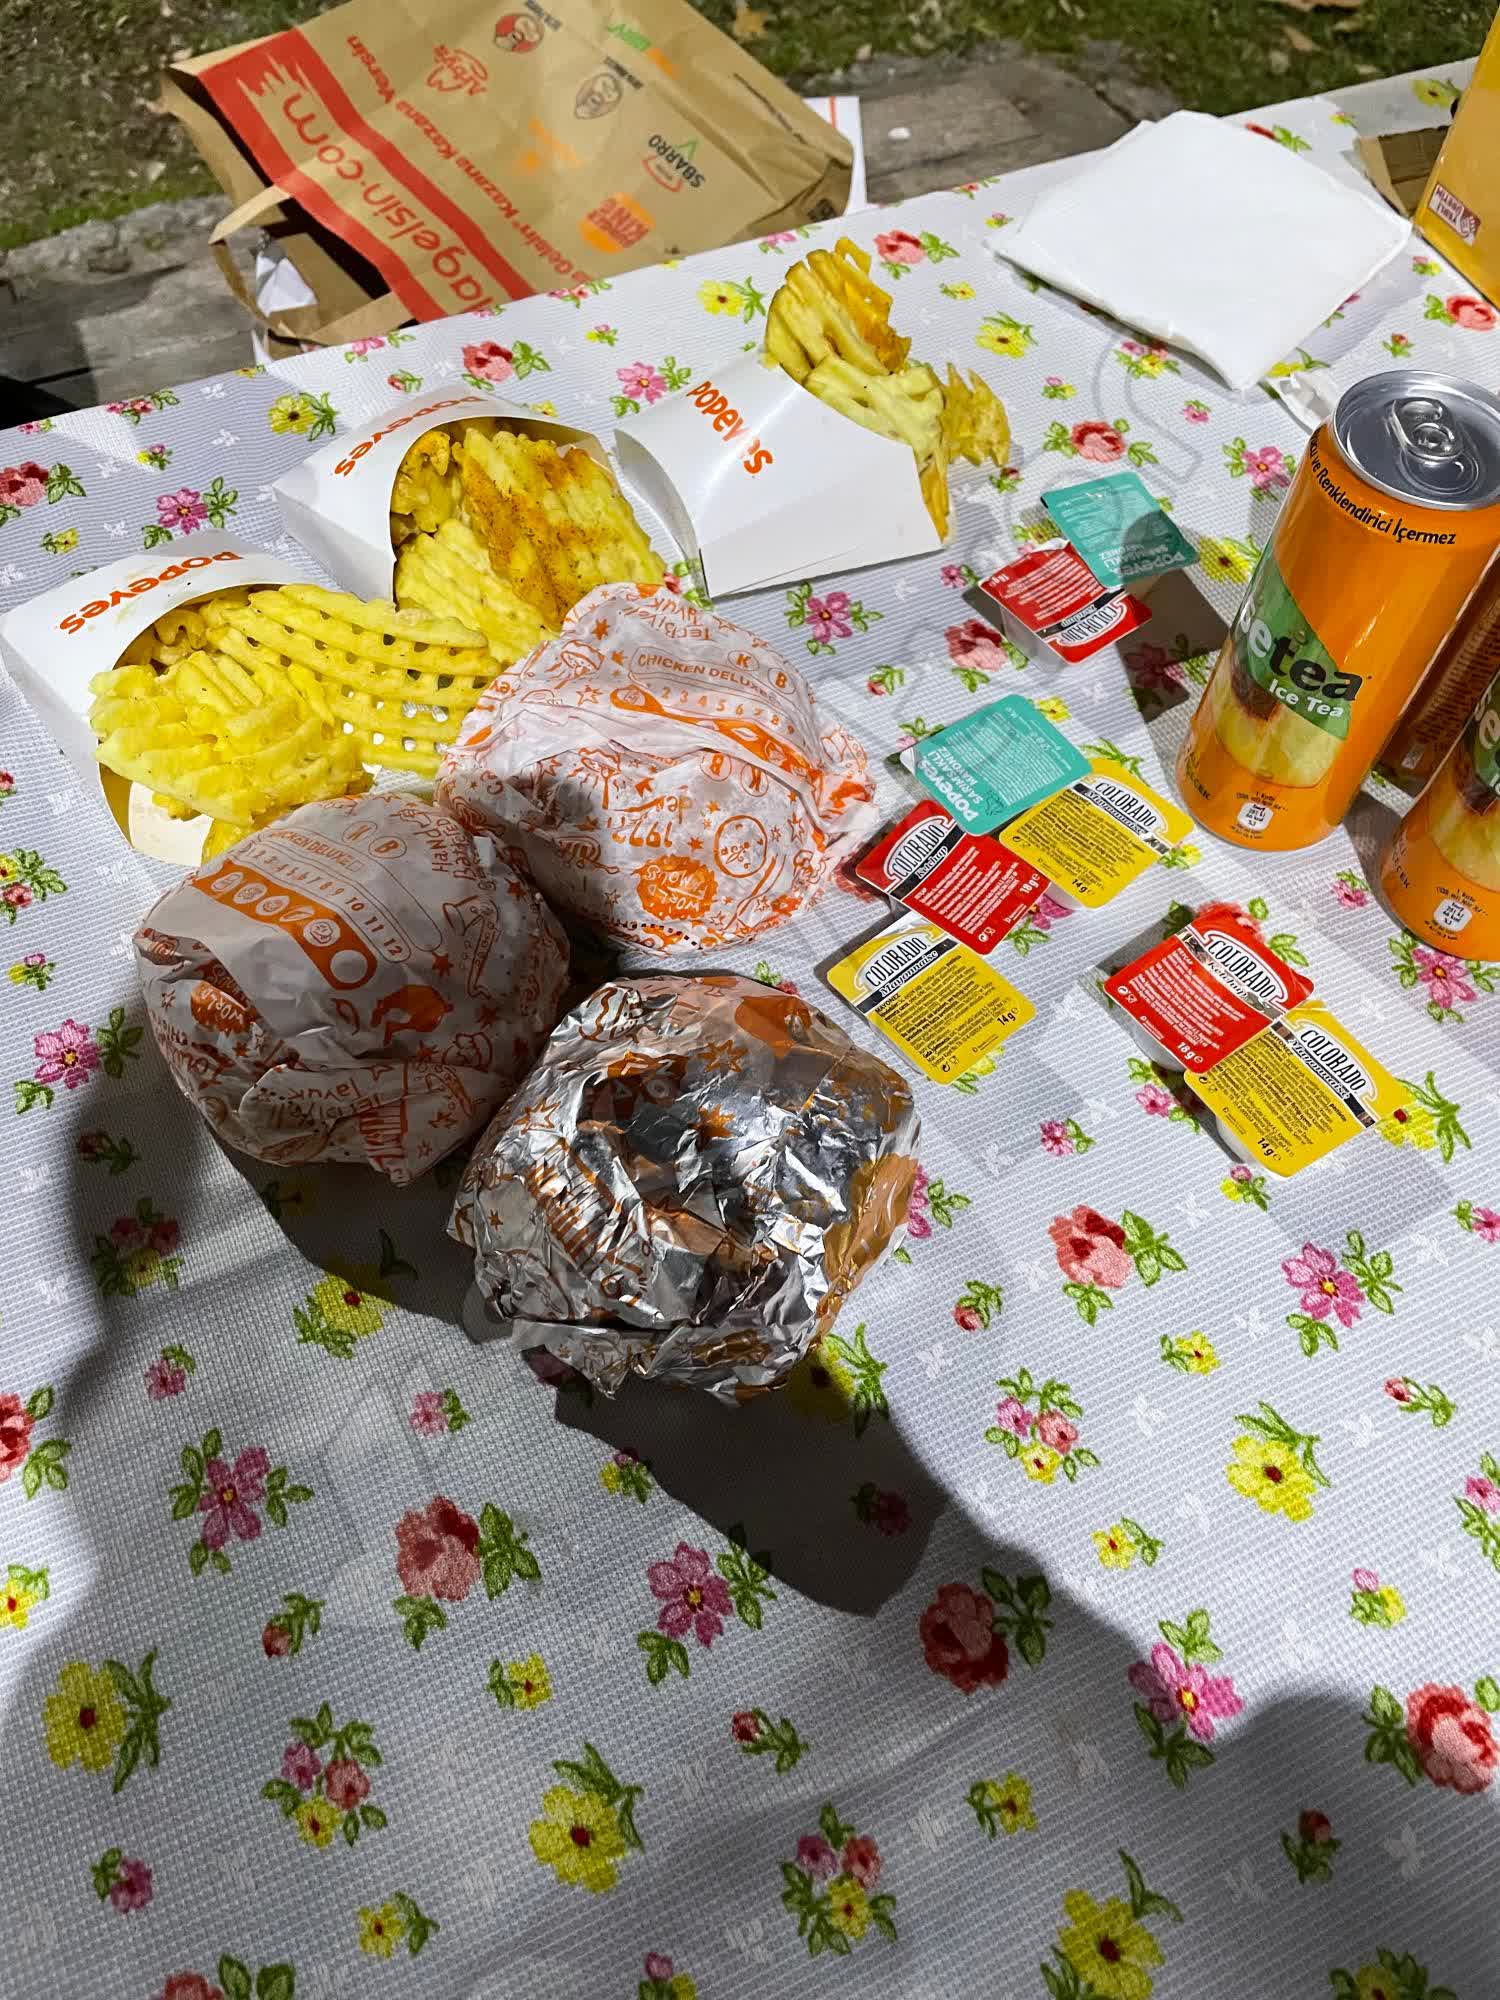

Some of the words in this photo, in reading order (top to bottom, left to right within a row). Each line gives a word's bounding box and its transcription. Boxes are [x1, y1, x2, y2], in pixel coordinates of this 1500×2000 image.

[647, 133, 706, 189] SBARRO
[1316, 467, 1394, 534] Renklendirici
[1393, 518, 1457, 544] İçermez
[1058, 604, 1120, 644] COLORADO
[637, 653, 706, 675] CHICKEN
[1268, 678, 1299, 705] Ice
[1306, 696, 1345, 718] Tea
[1094, 781, 1157, 828] COLORADO
[891, 823, 946, 879] COLORADO
[864, 936, 929, 987] COLORADO
[1207, 939, 1277, 999] COLORADO
[1300, 1029, 1367, 1093] COLORADO
